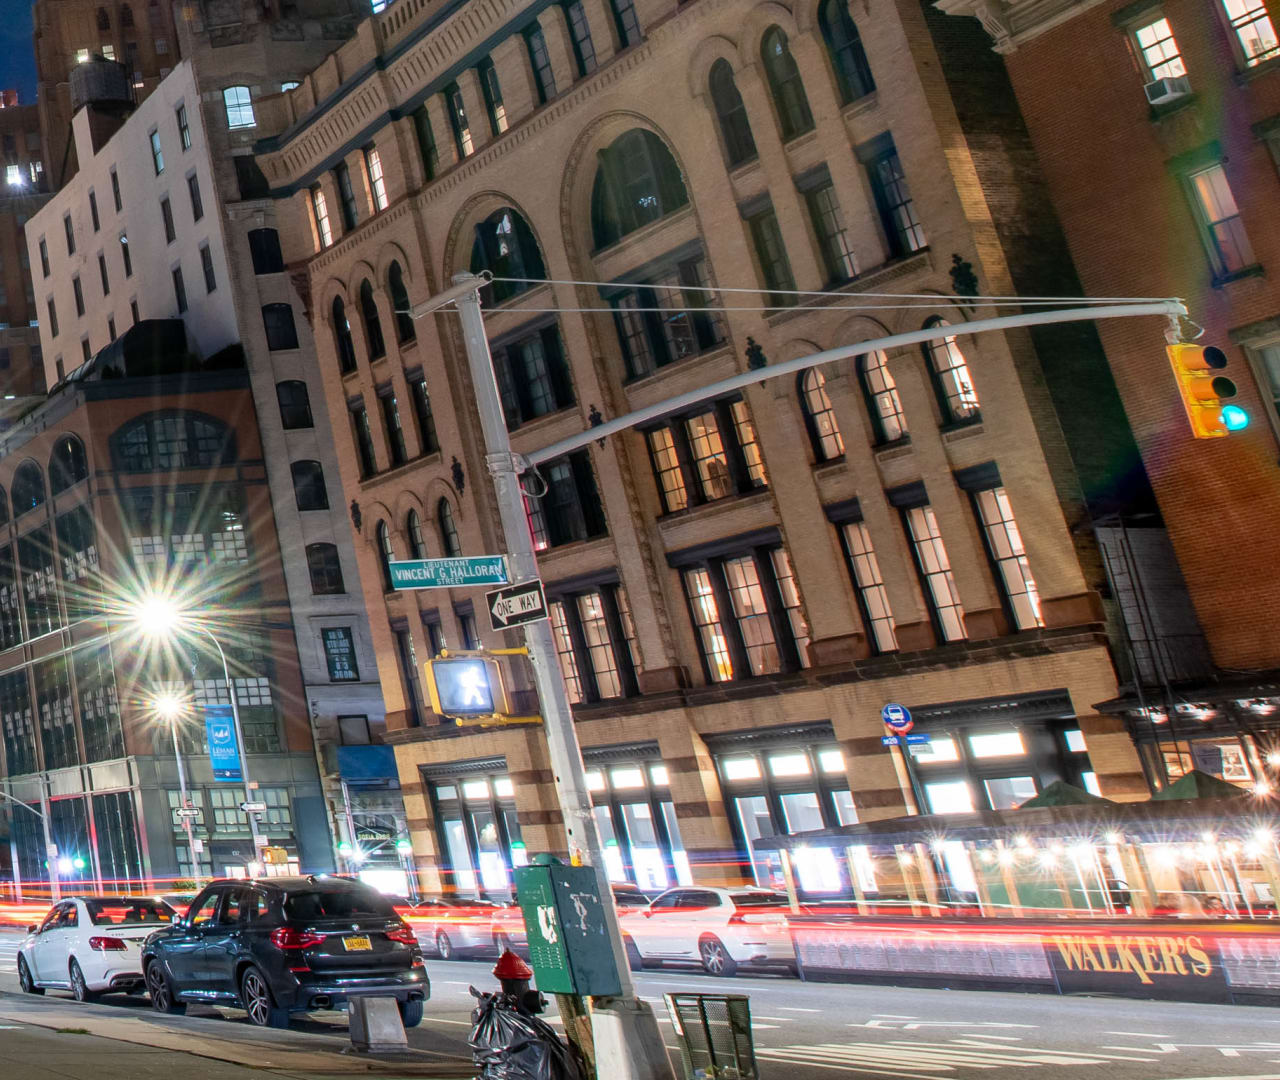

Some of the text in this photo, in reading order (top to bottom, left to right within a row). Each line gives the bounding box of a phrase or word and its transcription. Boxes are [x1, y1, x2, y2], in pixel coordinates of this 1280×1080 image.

[395, 568, 435, 581] VINCENT
[450, 564, 503, 578] HALLORAN
[423, 560, 470, 569] LIEUTENANT
[436, 577, 465, 585] STREET
[496, 594, 537, 617] ONE WAY
[1051, 934, 1213, 985] WALKER'S
